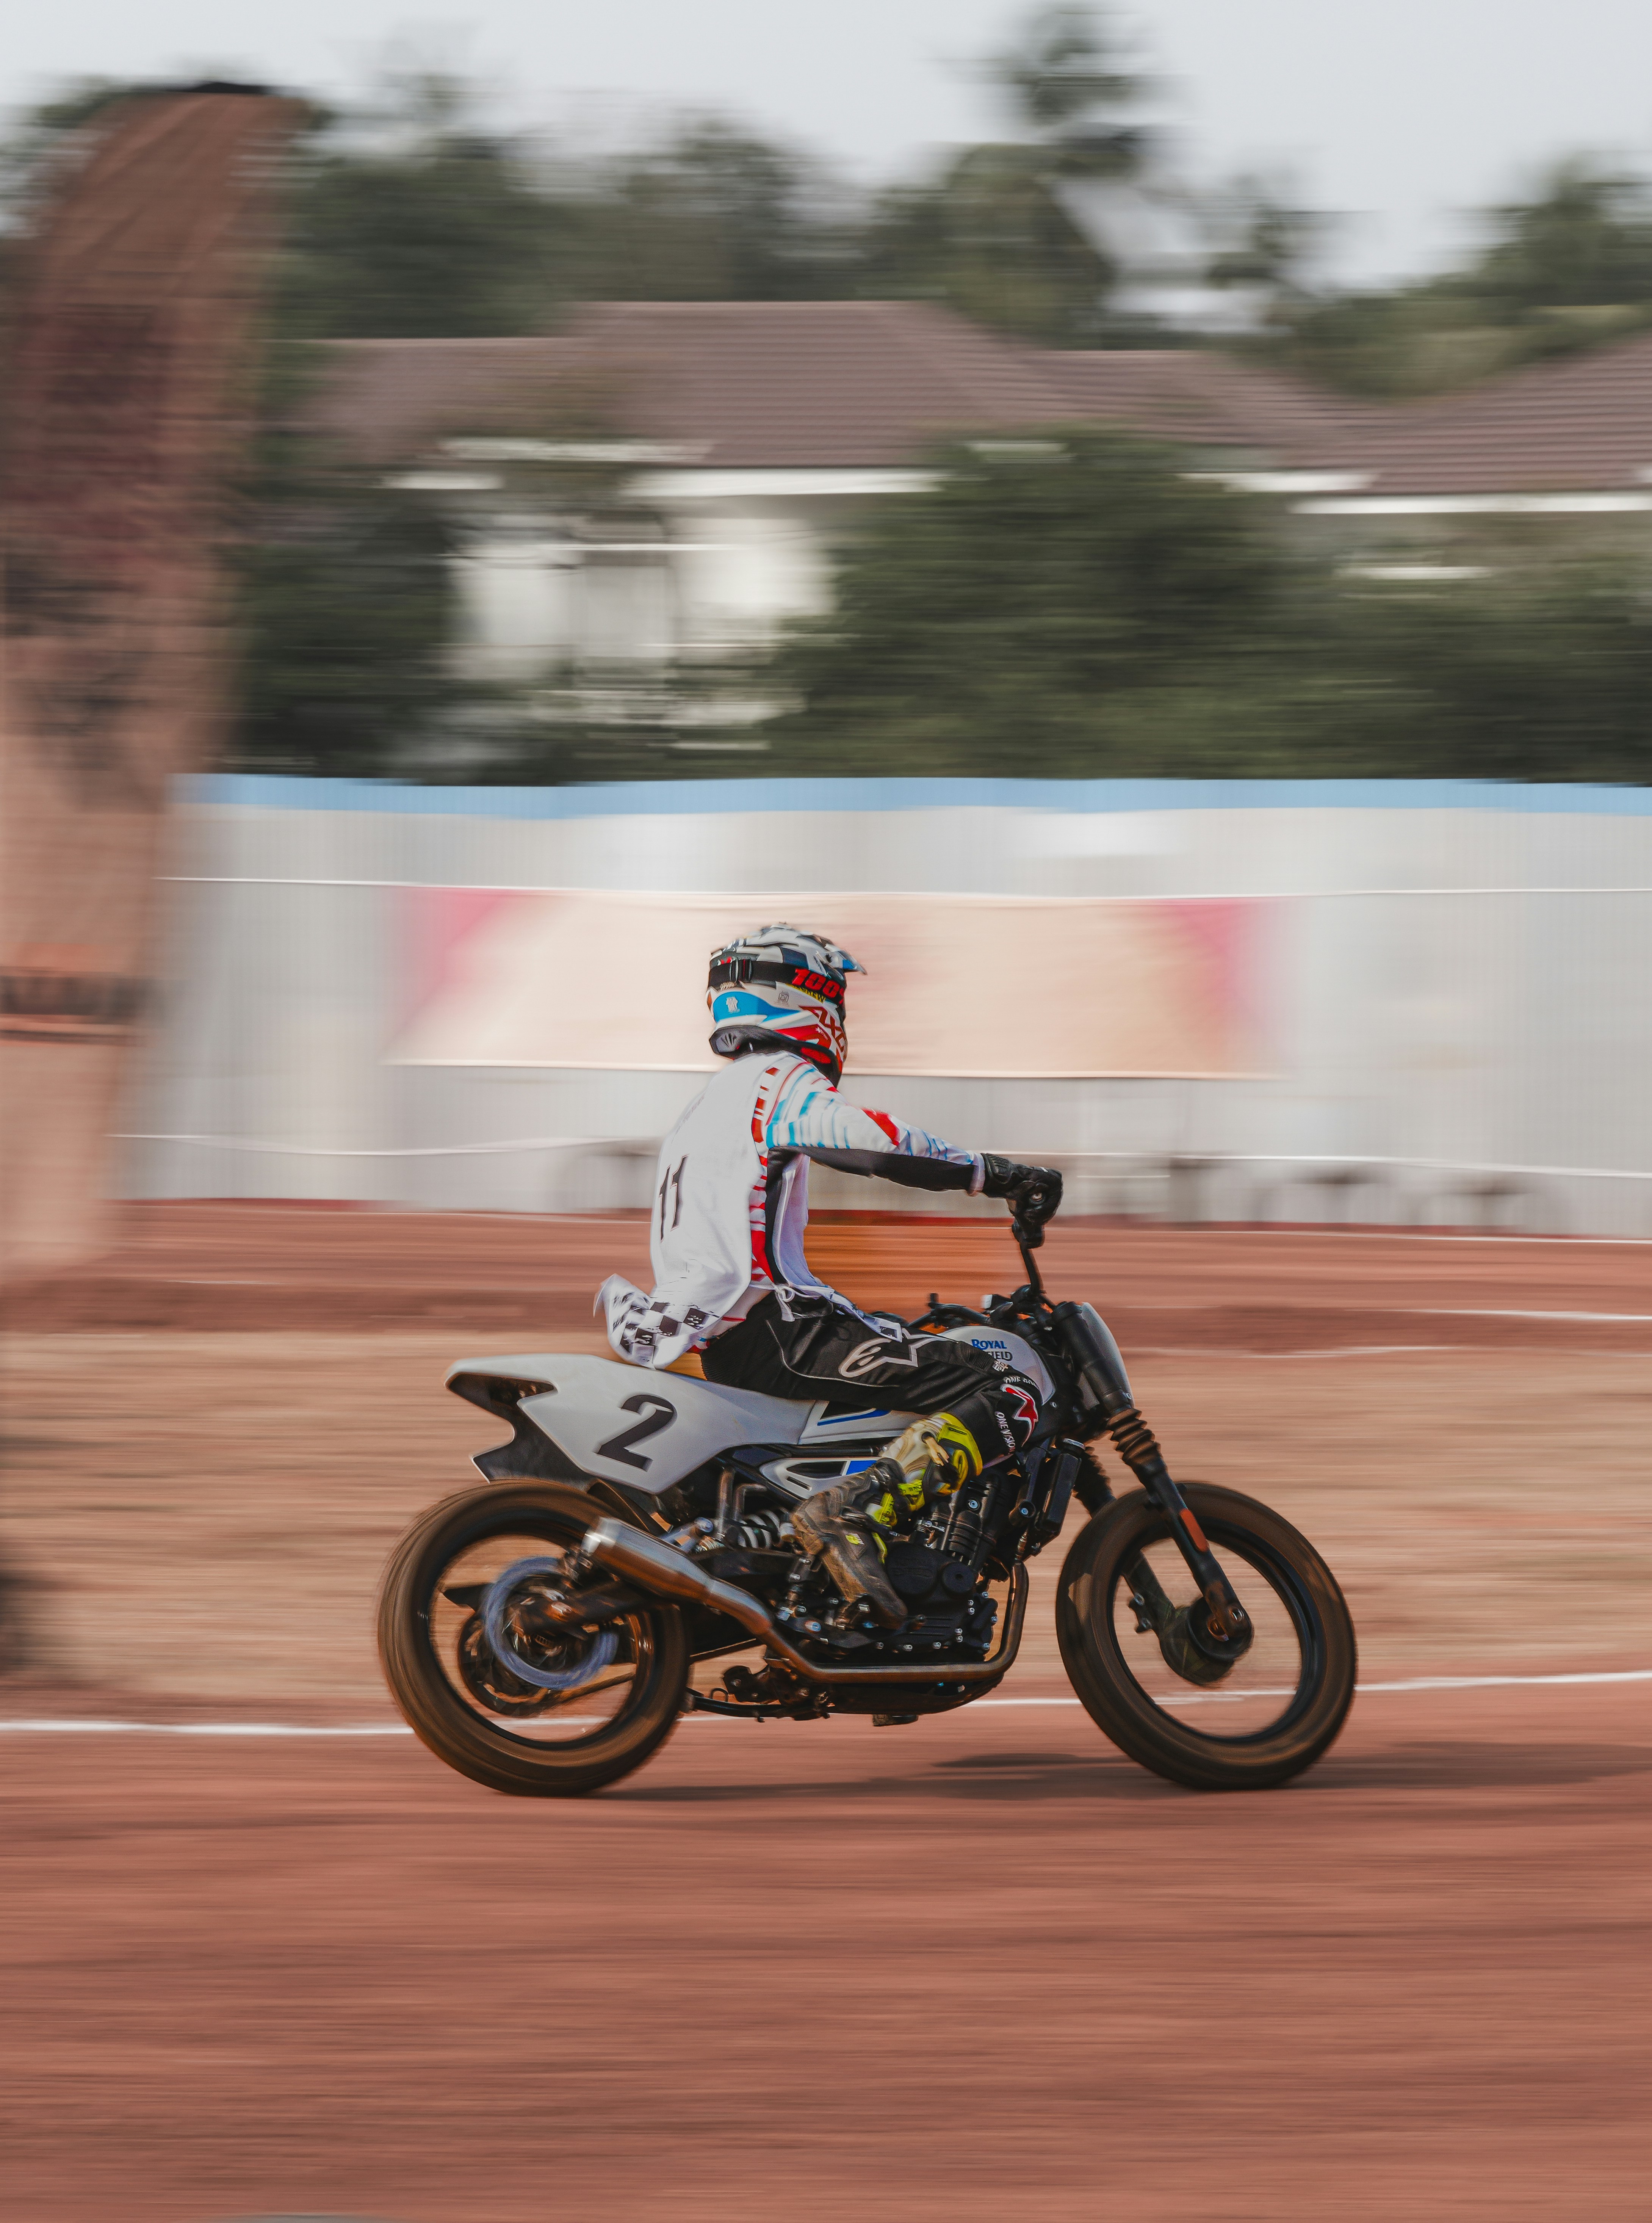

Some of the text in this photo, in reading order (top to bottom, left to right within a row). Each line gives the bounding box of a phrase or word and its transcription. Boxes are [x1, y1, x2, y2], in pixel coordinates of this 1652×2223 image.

[659, 1153, 690, 1243] 11
[971, 1339, 1007, 1350] ROYAL
[596, 1394, 678, 1472] 2
[994, 1411, 1008, 1429] ONE
